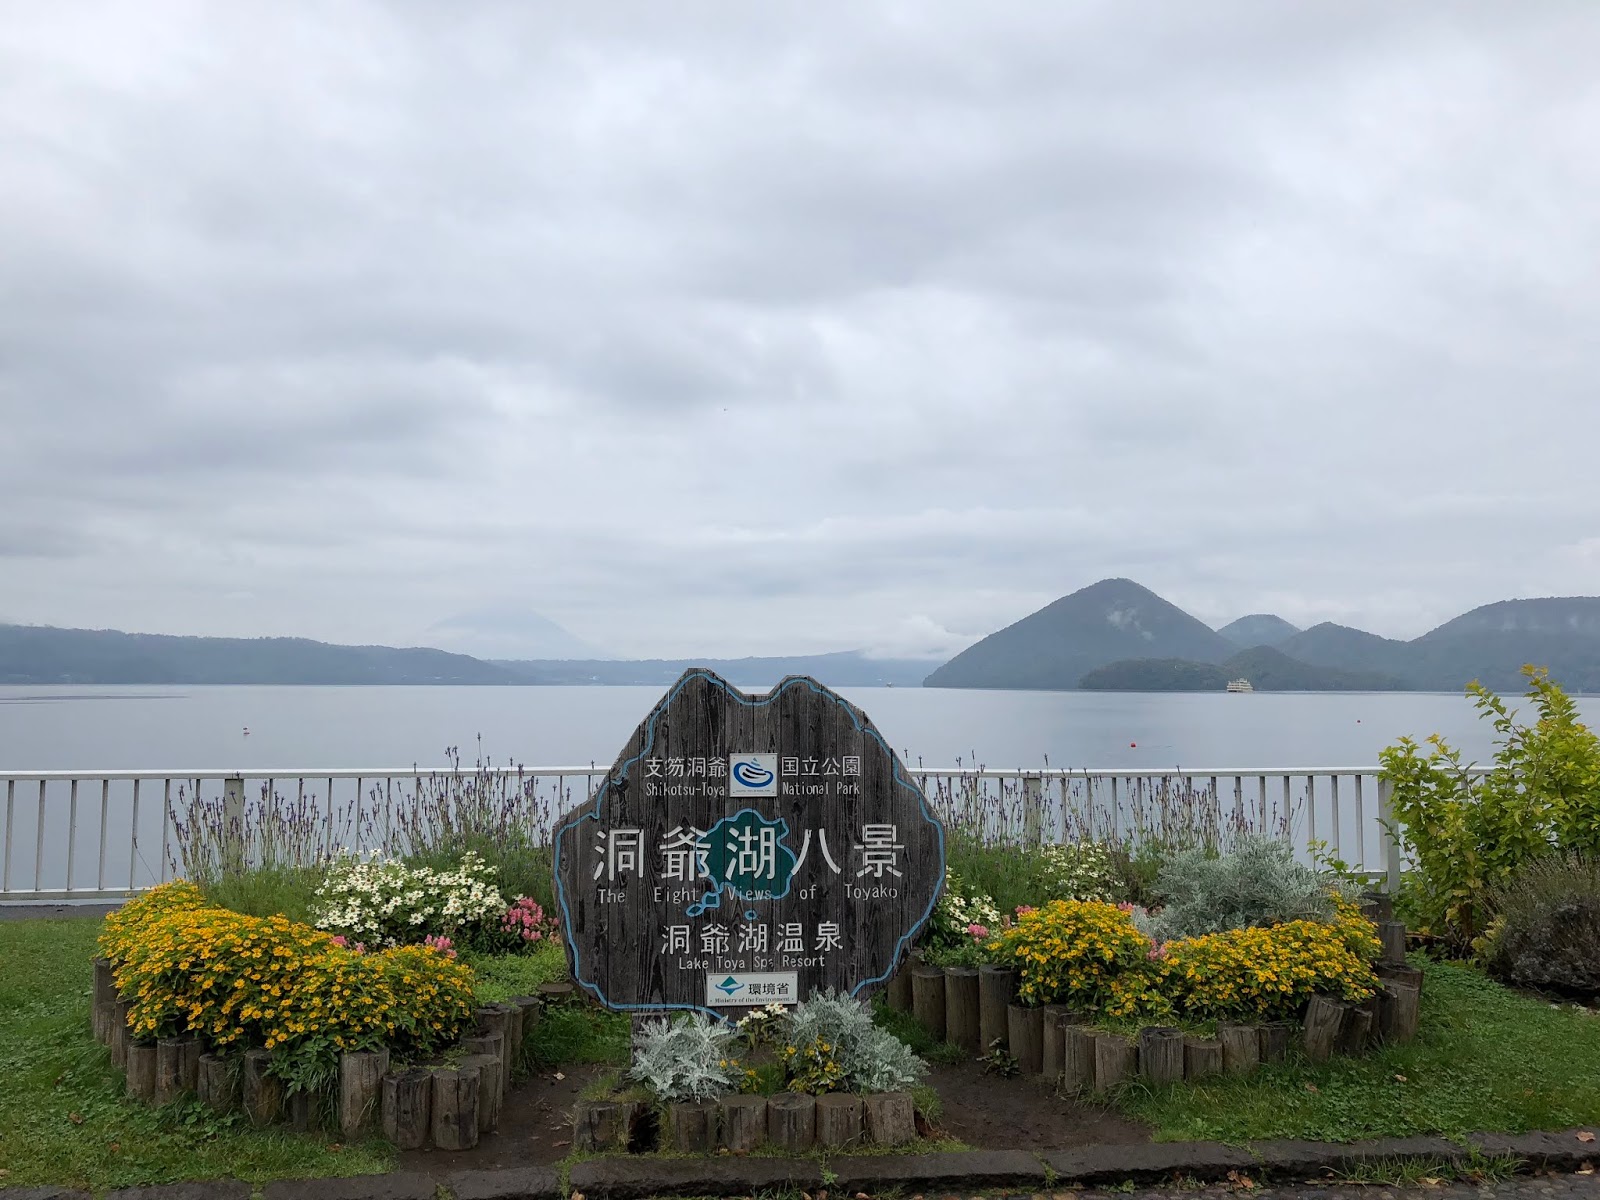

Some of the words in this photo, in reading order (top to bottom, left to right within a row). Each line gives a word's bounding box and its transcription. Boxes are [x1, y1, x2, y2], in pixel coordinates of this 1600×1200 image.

[781, 756, 861, 777] 国立公園
[646, 782, 725, 797] Shikotsu-Toya
[782, 782, 829, 795] National
[837, 782, 860, 795] Park
[593, 823, 905, 881] 洞爺湖八景
[598, 888, 625, 904] The
[654, 886, 699, 904] Eight
[727, 886, 772, 901] Views
[800, 884, 817, 900] of
[844, 883, 898, 901] Toyako
[661, 921, 843, 955] 洞爺湖温泉
[679, 958, 709, 970] Lake
[716, 956, 745, 971] Toya
[783, 955, 825, 968] Resort
[749, 983, 789, 995] 環境省
